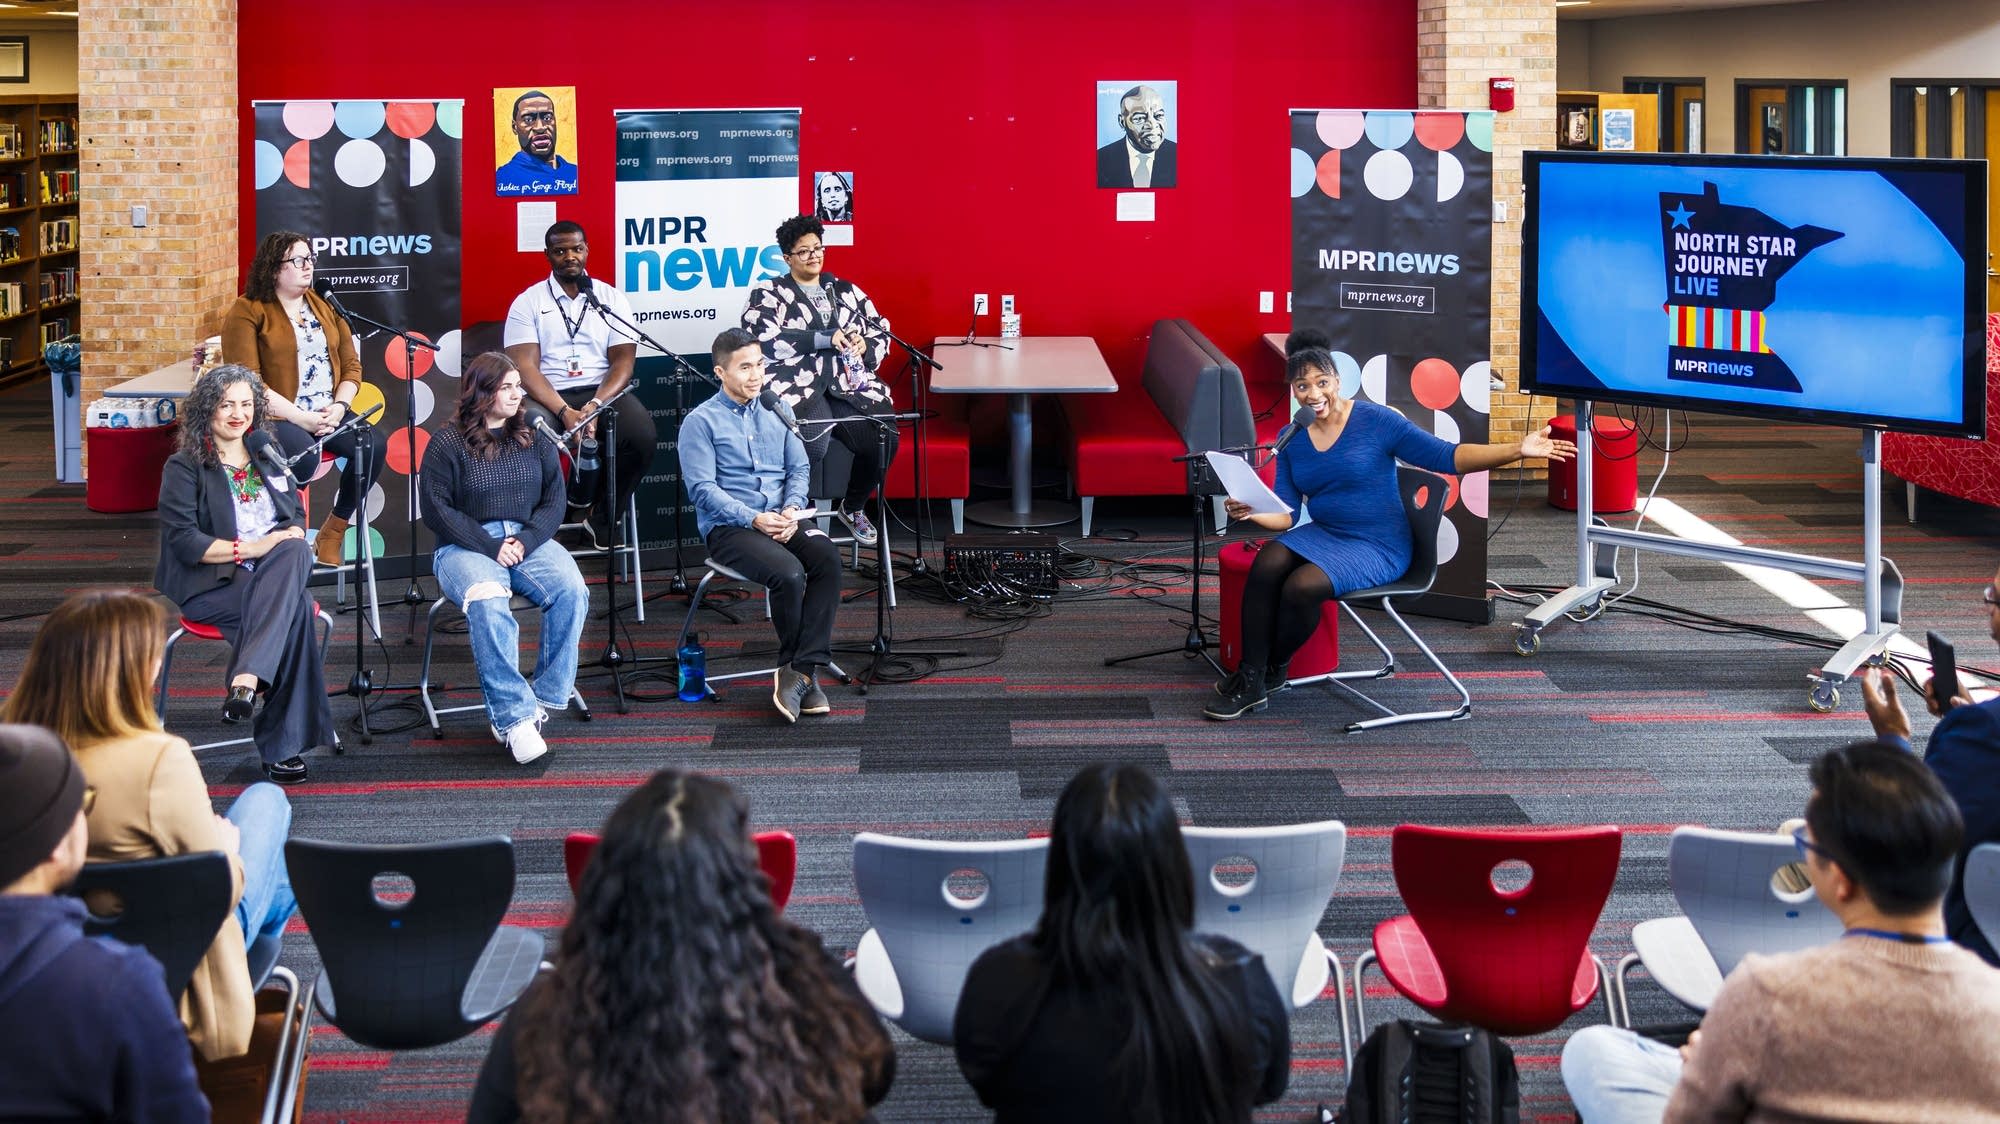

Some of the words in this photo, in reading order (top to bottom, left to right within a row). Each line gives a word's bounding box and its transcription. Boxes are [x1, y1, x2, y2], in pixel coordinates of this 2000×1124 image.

[622, 129, 699, 140] mprnews.org
[719, 128, 794, 139] mprnews.org
[656, 155, 733, 165] mprnews.org
[553, 179, 577, 192] Floyd
[624, 215, 707, 246] MPR
[307, 234, 433, 257] PRnews
[1675, 232, 1739, 254] NORTH
[1746, 236, 1796, 257] STAR
[1675, 255, 1768, 278] JOURNEY
[1674, 276, 1719, 297] LIVE
[1347, 290, 1426, 307] mprnews.org
